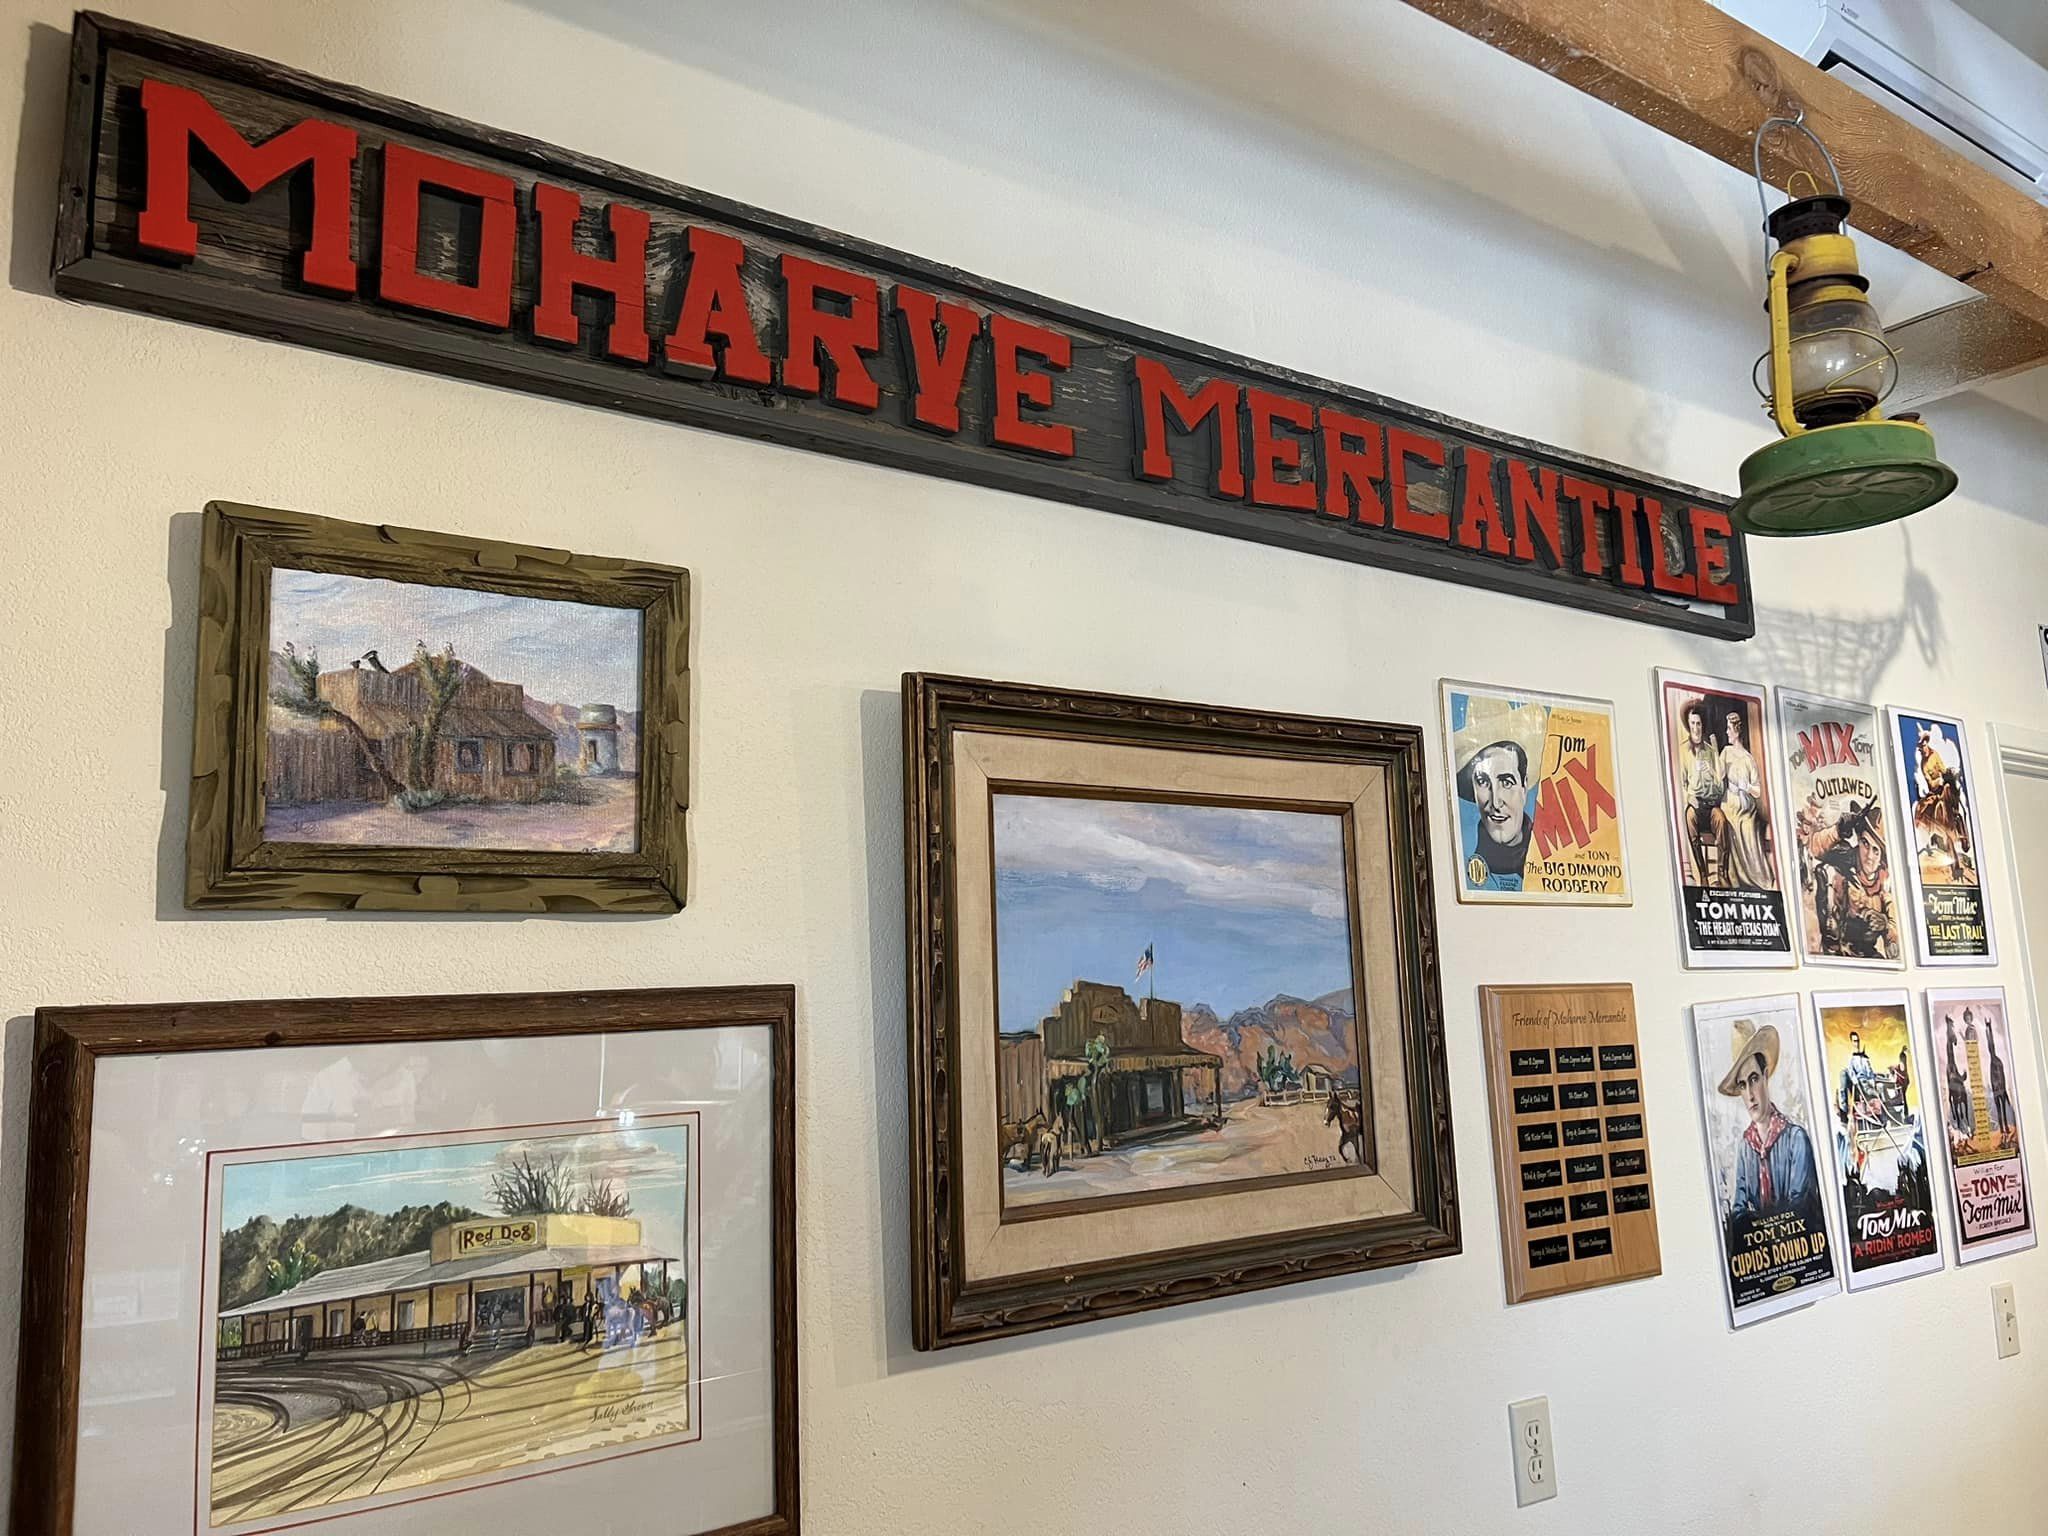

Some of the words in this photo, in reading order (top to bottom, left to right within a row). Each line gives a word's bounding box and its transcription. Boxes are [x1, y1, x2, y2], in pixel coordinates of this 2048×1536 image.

[137, 78, 1075, 459] MOHARVE
[1130, 355, 1740, 605] MERCANTILE
[1548, 733, 1586, 775] Tom
[1797, 721, 1860, 774] MIX
[1815, 777, 1873, 800] OUTLAWED
[1531, 744, 1617, 860] MIX
[1587, 850, 1611, 862] TONY
[1526, 860, 1543, 875] The
[1544, 861, 1566, 877] BIG
[1568, 863, 1622, 879] DIAMOND
[1541, 877, 1609, 894] ROBBERY
[1695, 902, 1738, 919] TOM
[1740, 903, 1776, 921] MIX
[1928, 893, 1953, 915] Tom
[1953, 896, 1978, 915] Mix
[1713, 921, 1735, 936] HEART
[1741, 921, 1762, 936] TEXAS
[1940, 923, 1961, 940] LAST
[1960, 923, 1985, 940] TRAIL
[1512, 1009, 1541, 1027] Friends
[1543, 1009, 1552, 1030] of
[1971, 1174, 2008, 1197] TONY
[1962, 1199, 1993, 1224] Tom
[1993, 1190, 2023, 1217] Mix
[1752, 1214, 1780, 1227] WILLIAM
[1780, 1211, 1795, 1220] FOX
[1857, 1210, 1891, 1240] TOM
[1889, 1208, 1926, 1230] MIX
[463, 1227, 494, 1249] Red
[501, 1222, 532, 1242] Dog
[1743, 1227, 1776, 1246] TOM
[1779, 1218, 1806, 1237] MIX
[1897, 1228, 1932, 1248] ROMEO
[1731, 1245, 1771, 1278] CUPID'S
[1772, 1236, 1809, 1266] ROUND
[1810, 1231, 1826, 1255] UP
